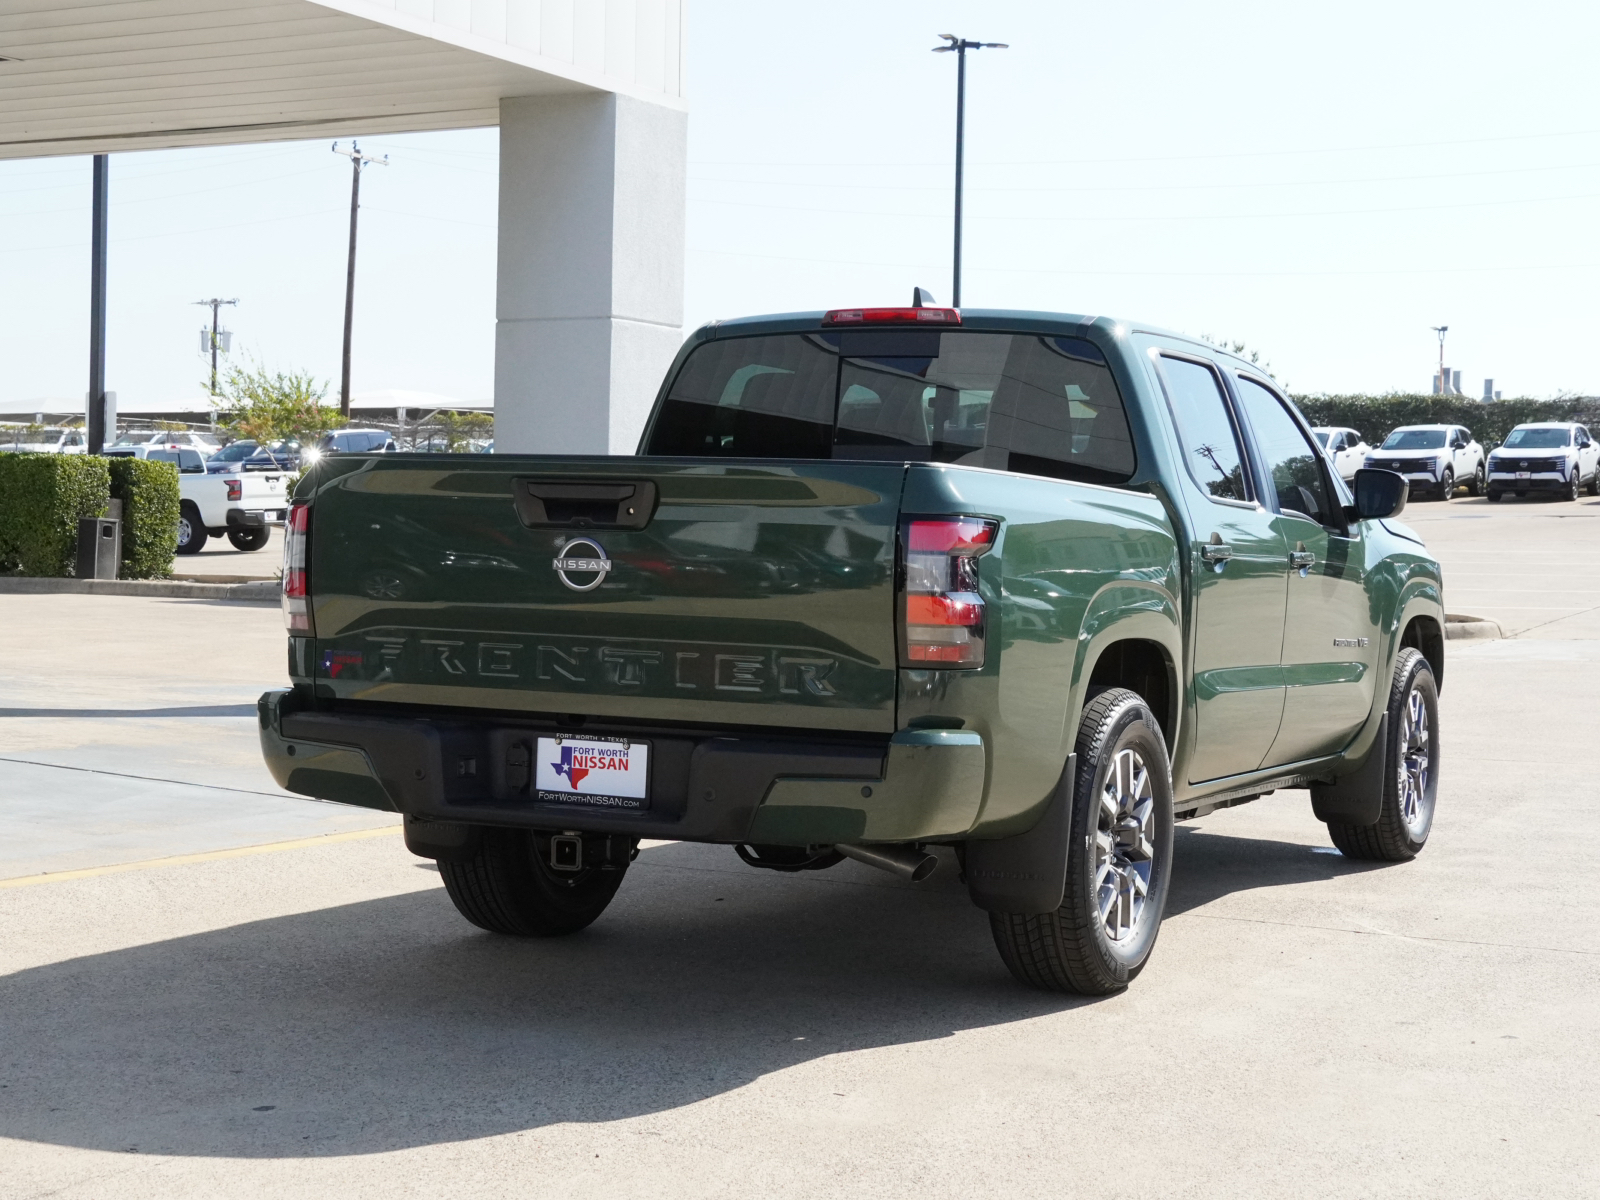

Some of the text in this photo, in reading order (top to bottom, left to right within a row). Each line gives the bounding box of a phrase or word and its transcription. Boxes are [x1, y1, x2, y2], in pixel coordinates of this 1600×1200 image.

[553, 560, 610, 569] NISSAN
[365, 636, 838, 696] FRONTIER
[573, 747, 629, 758] FORT WORTH
[573, 755, 629, 771] NISSAN
